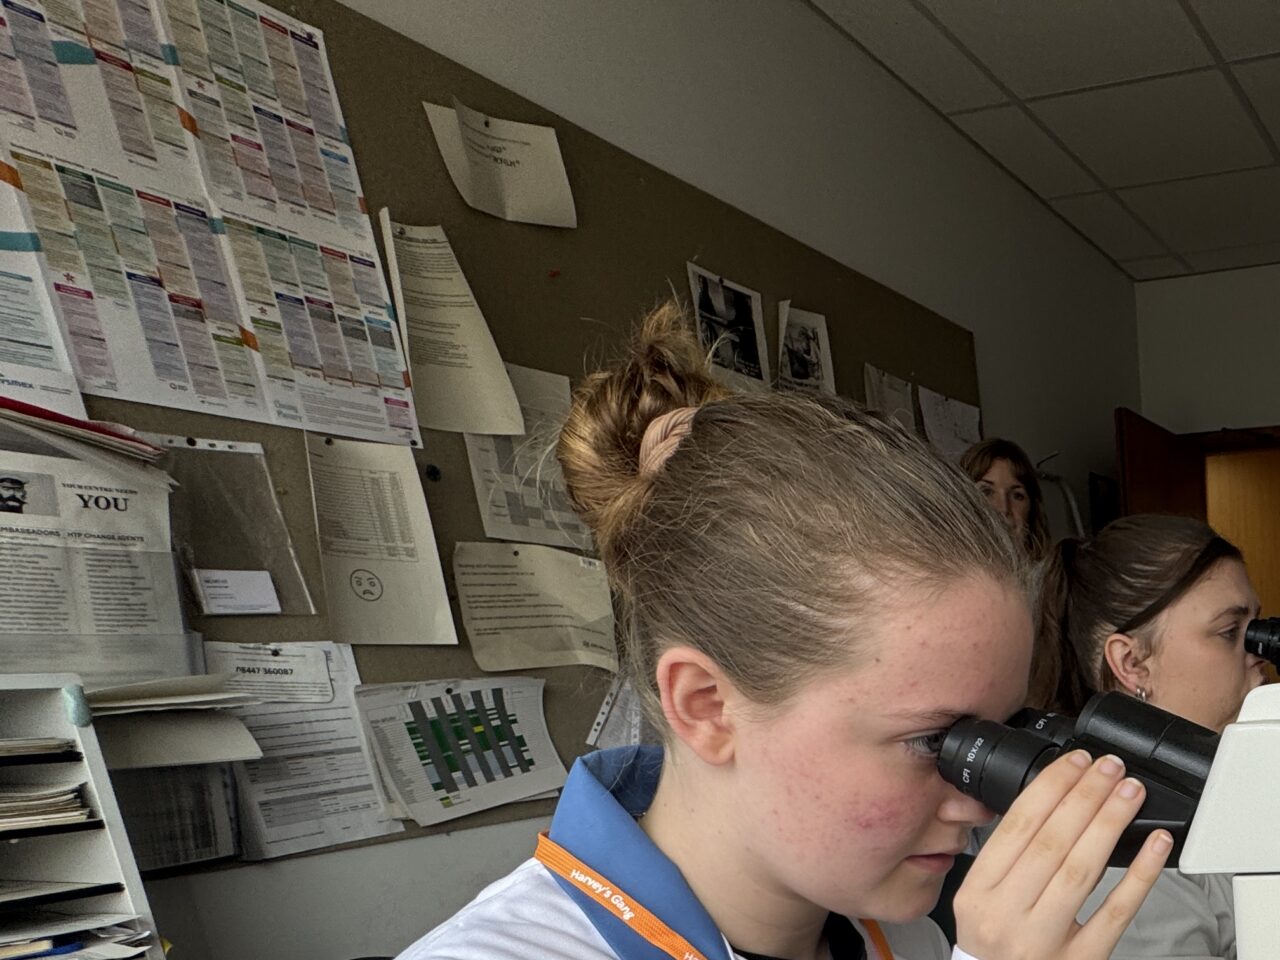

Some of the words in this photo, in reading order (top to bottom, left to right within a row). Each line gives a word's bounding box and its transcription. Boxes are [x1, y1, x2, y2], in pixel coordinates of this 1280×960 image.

[76, 493, 129, 512] YOU
[0, 526, 61, 538] MBASSADORS
[1035, 718, 1048, 730] CFI
[962, 768, 971, 784] CFI
[570, 868, 613, 898] Harvey's
[611, 894, 635, 921] Gang
